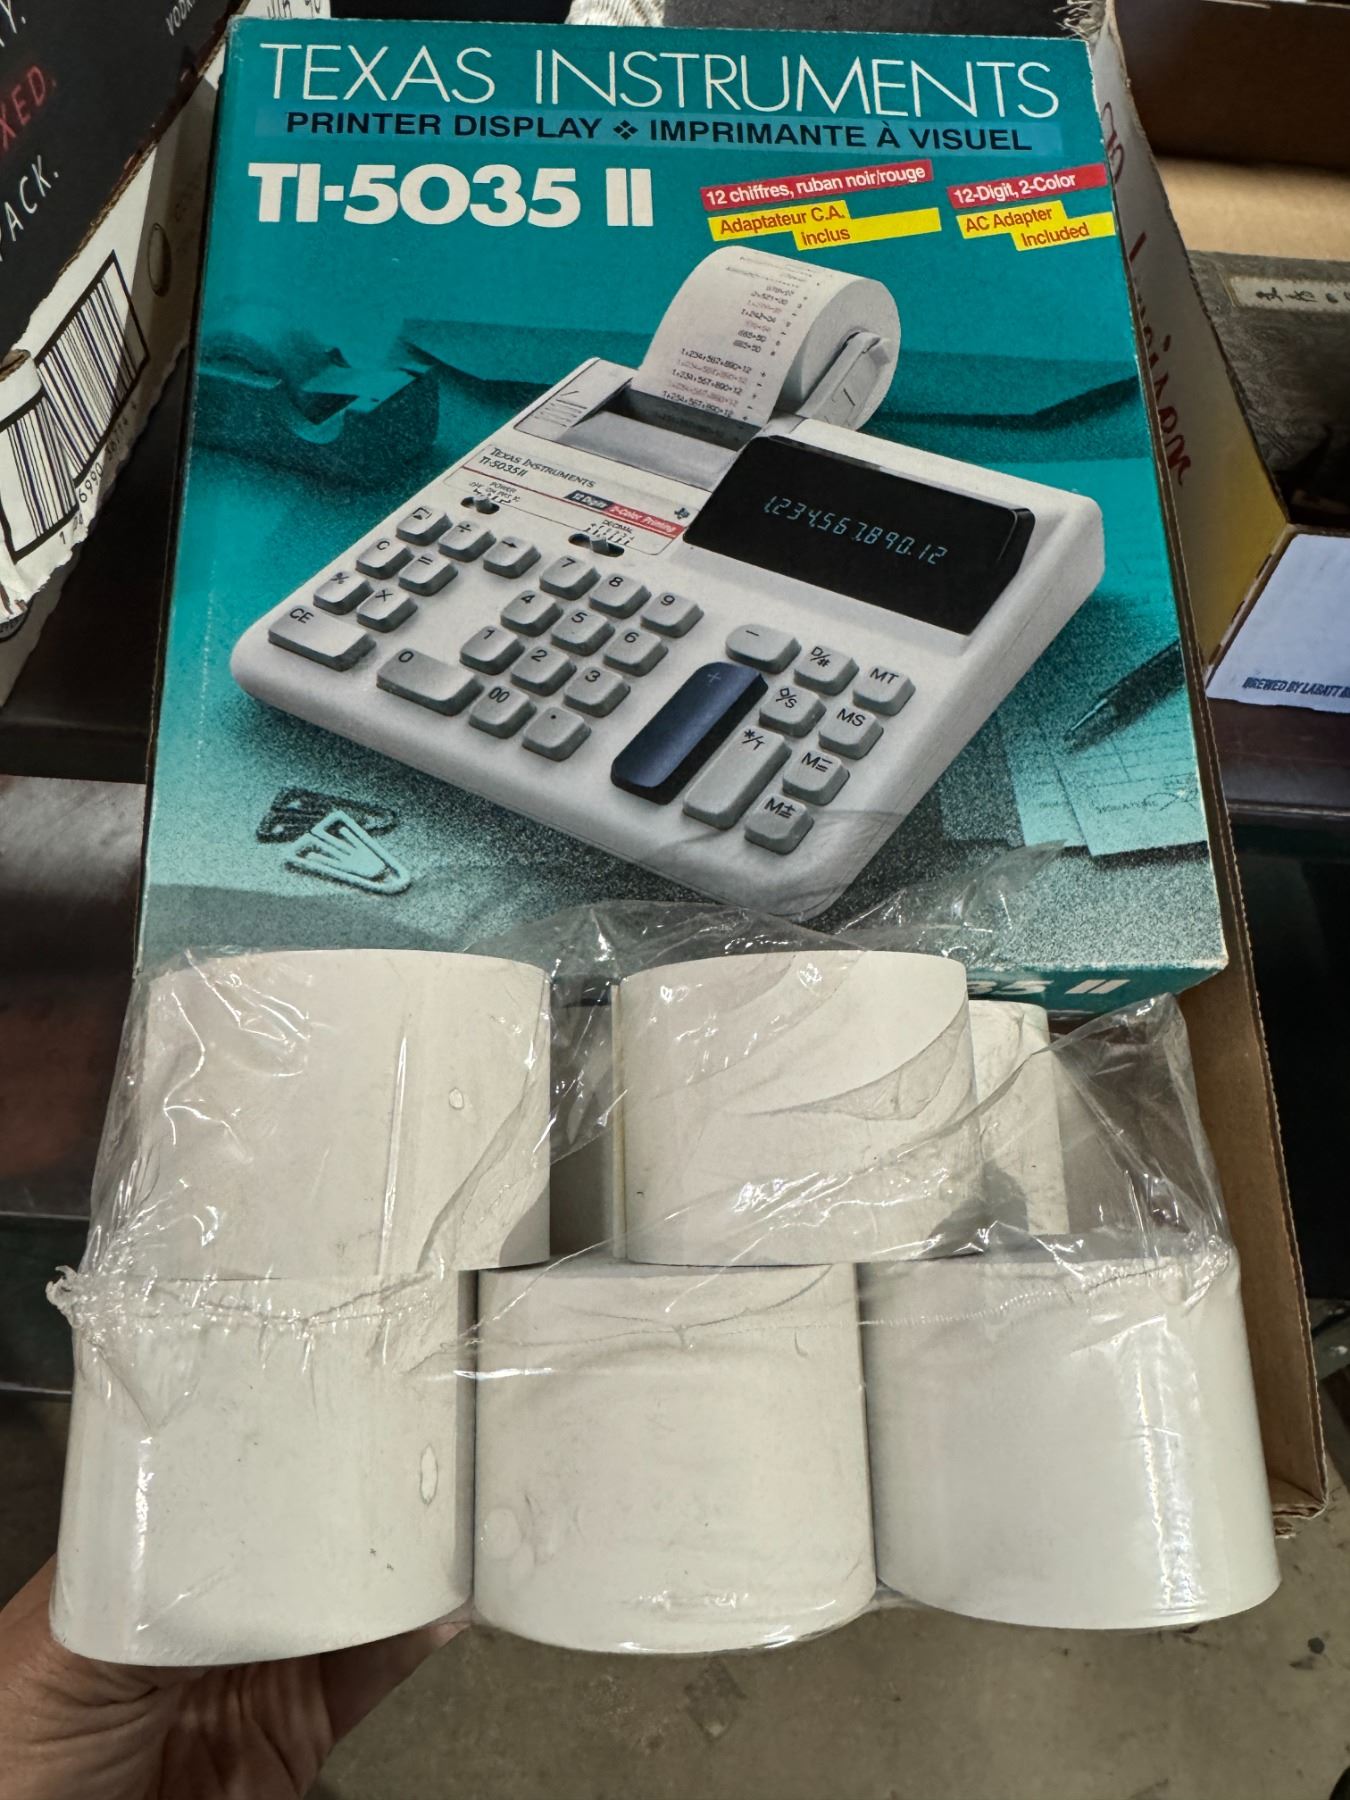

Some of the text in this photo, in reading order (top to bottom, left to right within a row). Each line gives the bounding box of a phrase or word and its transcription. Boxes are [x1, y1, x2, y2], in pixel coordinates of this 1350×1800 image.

[259, 43, 1059, 119] TEXAS INSTRUMENTS
[285, 111, 602, 140] PRINTER DISPLAY
[649, 119, 1033, 151] IMPRIMANTE À VISUEL
[706, 165, 927, 206] 12 chiffres, ruban noir/rouge
[954, 173, 1076, 205] 12-Digit, 2-Color
[247, 162, 654, 228] TI-5035 II
[0, 155, 59, 262] ACK.
[719, 207, 845, 236] Adaptateur C.A.
[965, 207, 1053, 234] AC Adapter
[801, 228, 851, 246] inclus
[1020, 223, 1090, 247] Included
[523, 458, 597, 488] INSTRUMENTS
[561, 557, 576, 568] 7
[608, 576, 624, 588] 8
[521, 594, 536, 605] 4
[660, 595, 675, 606] 9
[289, 608, 314, 624] CE
[571, 612, 587, 624] 5
[624, 631, 639, 643] 6
[531, 649, 548, 662] 2
[585, 670, 600, 683] 3
[869, 668, 899, 684] MT
[1300, 682, 1343, 697] LABATT
[836, 708, 866, 727] MS
